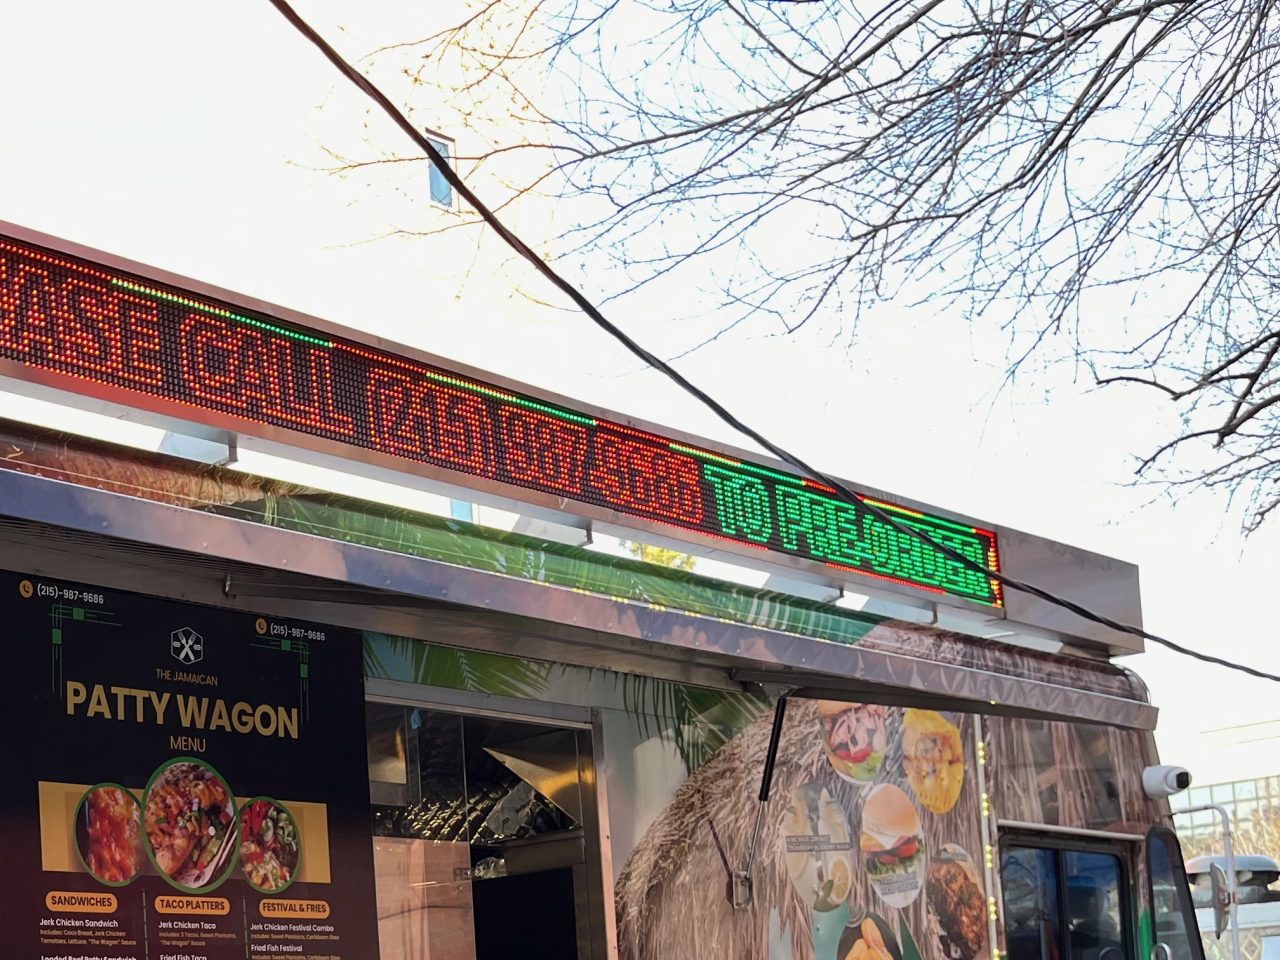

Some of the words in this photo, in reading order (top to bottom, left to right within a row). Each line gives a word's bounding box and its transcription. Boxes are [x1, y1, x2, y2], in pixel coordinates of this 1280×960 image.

[180, 313, 354, 436] CALL
[37, 584, 104, 604] (215)-987-9686
[156, 668, 171, 681] THE
[173, 671, 218, 687] JAMAICAN
[66, 680, 170, 724] PATTY
[177, 693, 299, 739] WAGON
[170, 735, 206, 753] MENU
[51, 896, 112, 906] SANDWICHES
[160, 900, 184, 909] TACO
[186, 901, 224, 910] PLATTERS
[263, 903, 297, 912] FESTIVAL
[299, 904, 305, 912] &
[307, 904, 326, 913] FRIES
[40, 918, 54, 926] Jerk
